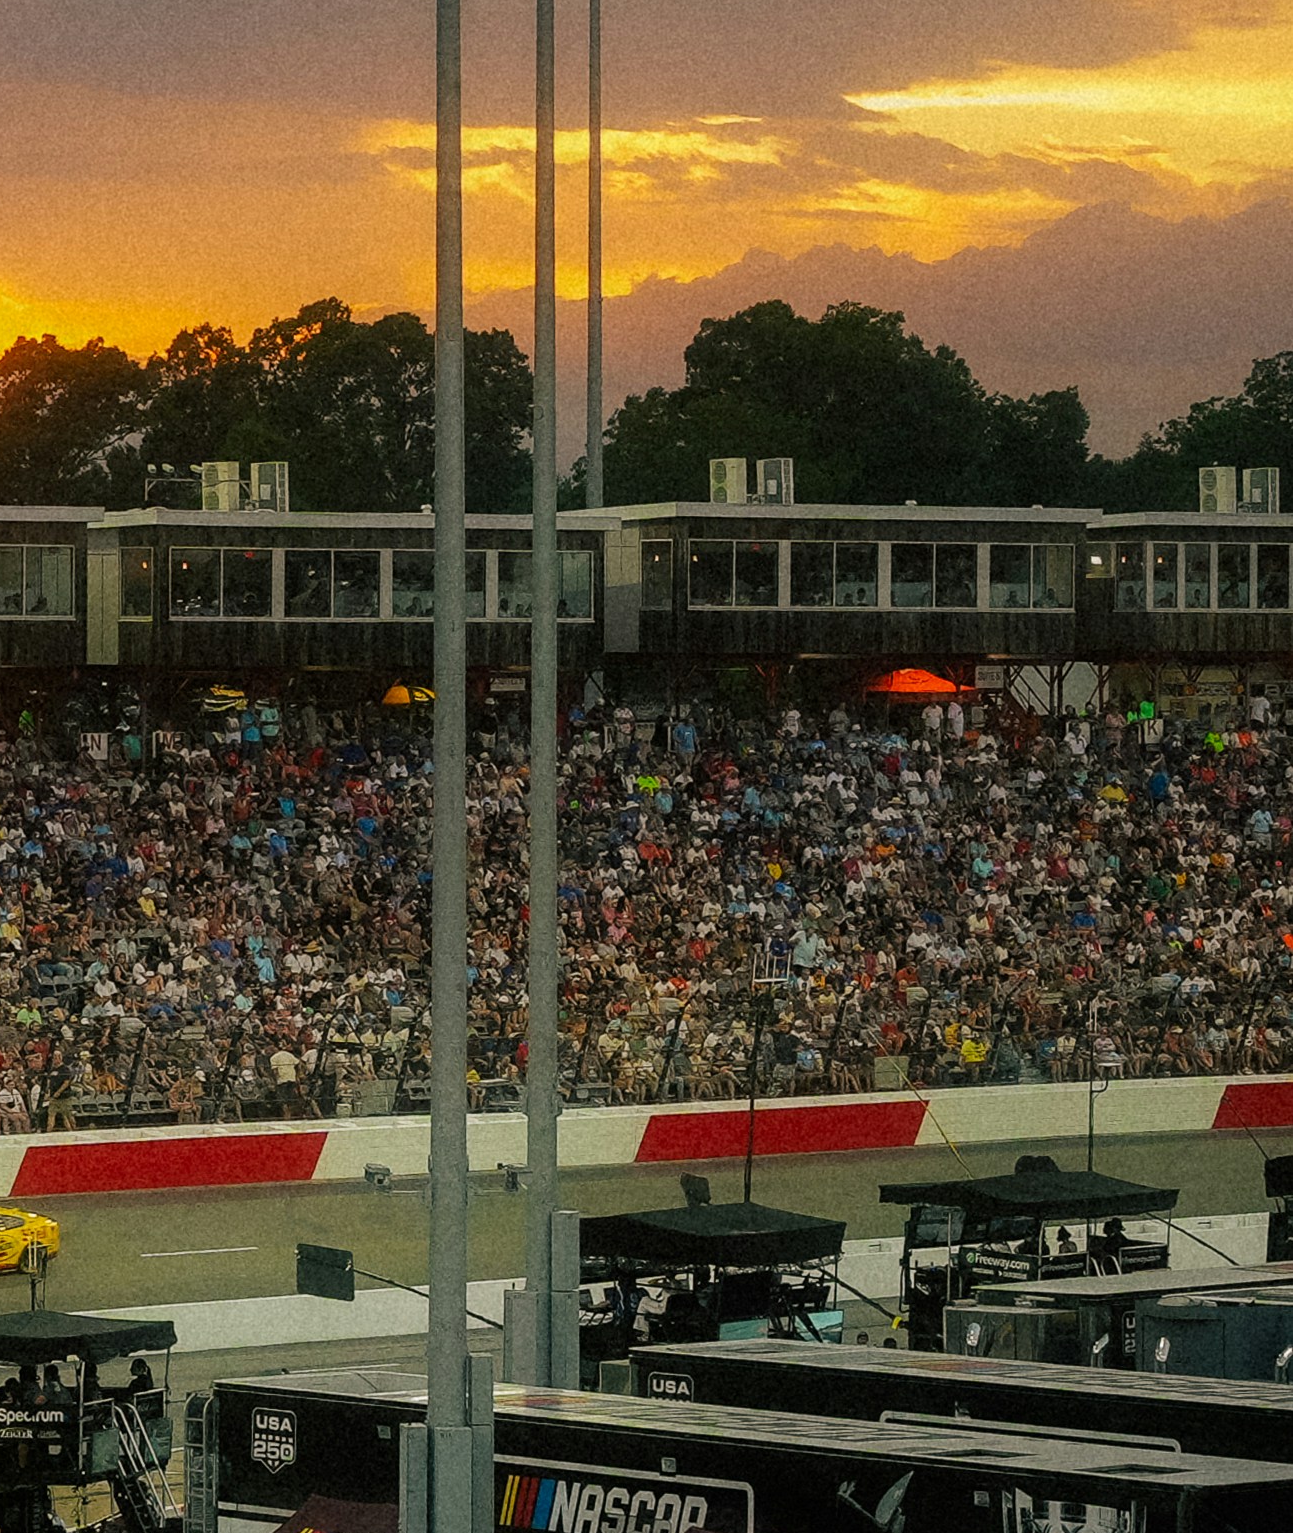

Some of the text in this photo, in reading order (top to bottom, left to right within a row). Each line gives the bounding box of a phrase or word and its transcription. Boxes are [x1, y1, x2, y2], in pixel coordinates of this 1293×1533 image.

[1147, 720, 1158, 736] K
[90, 735, 102, 751] N
[975, 1253, 1030, 1270] Freeway.com
[652, 1379, 690, 1395] USA
[257, 1414, 293, 1432] USA
[253, 1440, 294, 1461] 250
